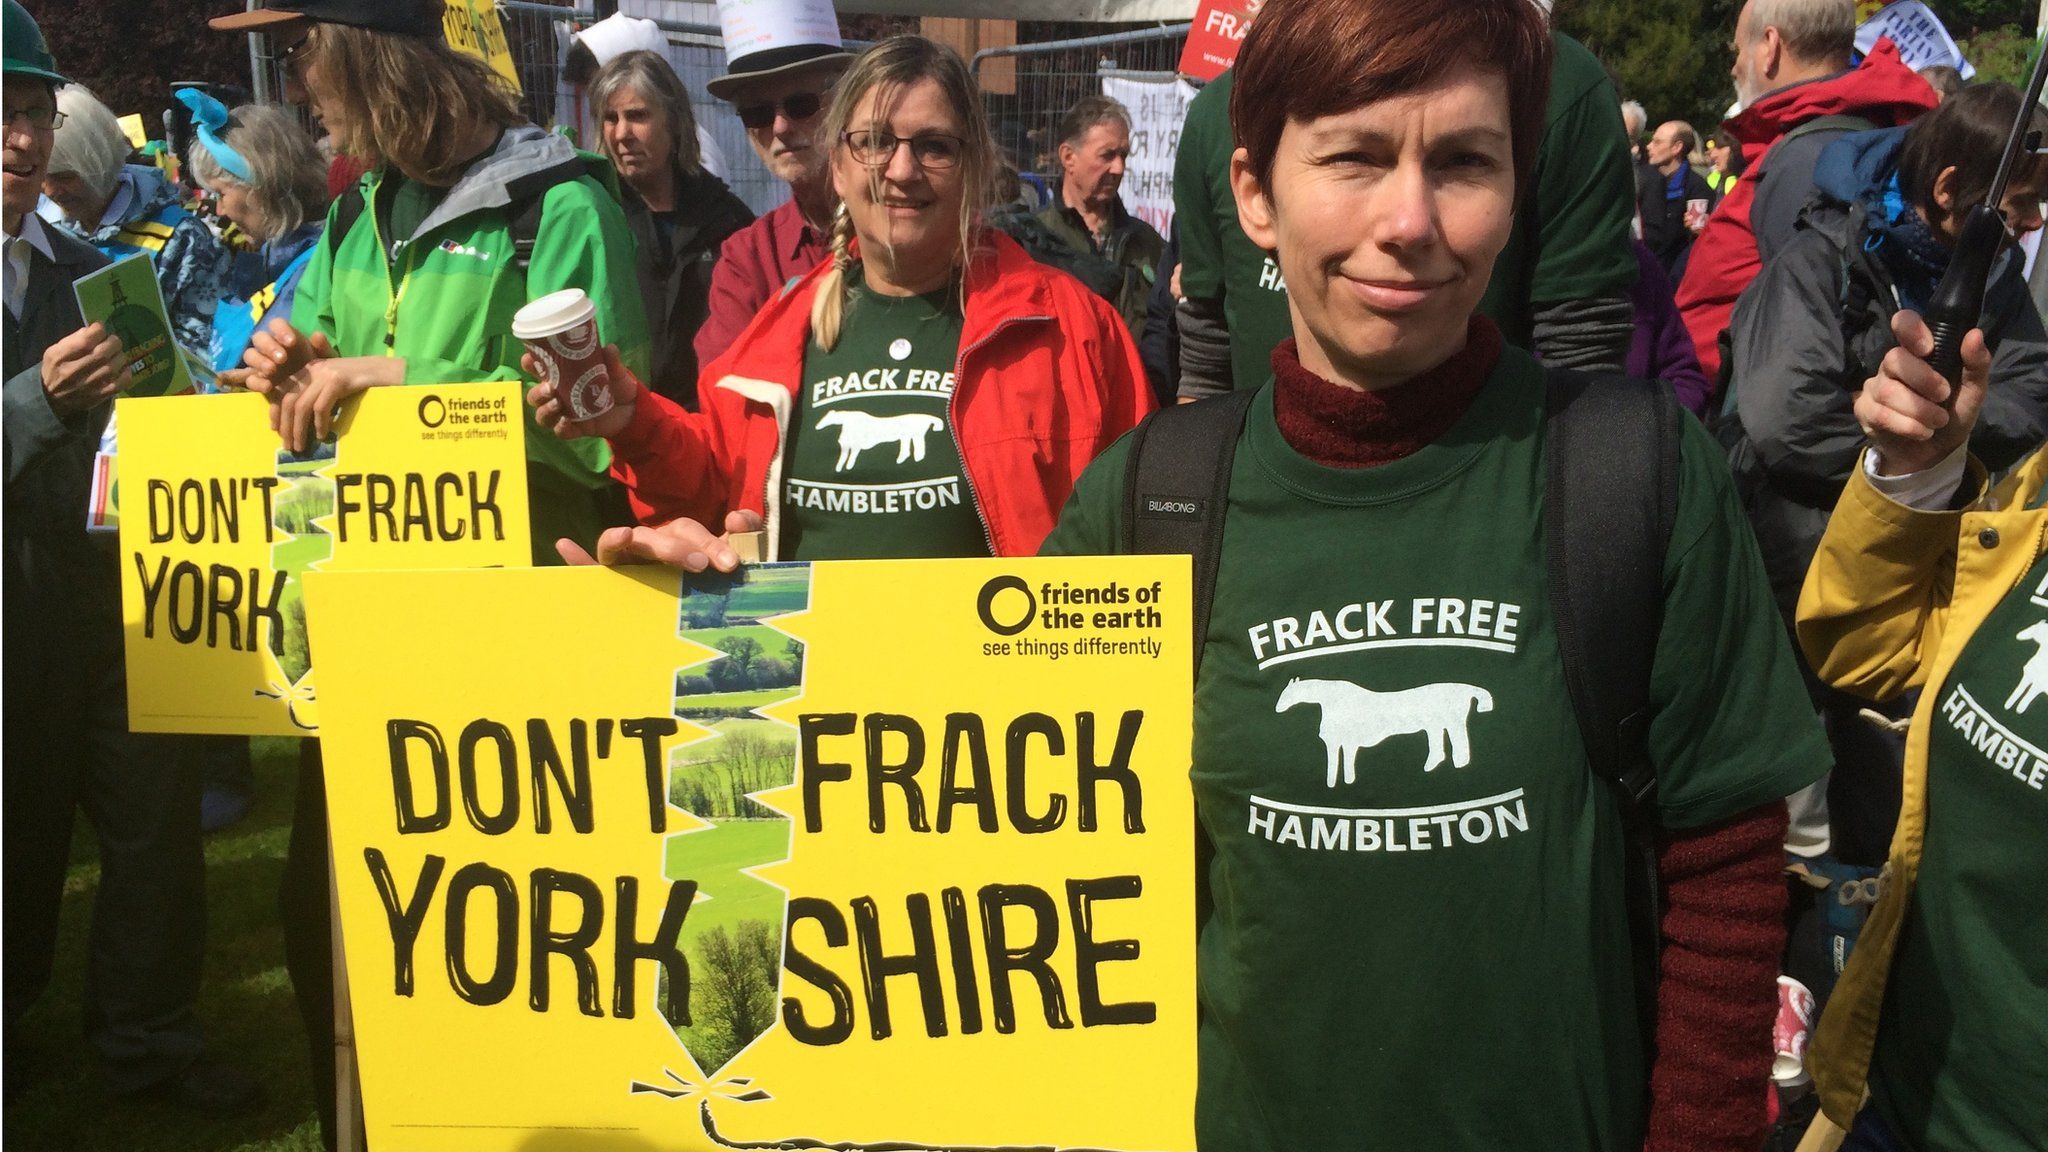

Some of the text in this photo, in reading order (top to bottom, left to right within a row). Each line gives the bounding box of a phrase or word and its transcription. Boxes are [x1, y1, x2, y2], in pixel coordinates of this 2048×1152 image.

[1205, 8, 1253, 41] FRA
[812, 368, 956, 402] FRACK FRE
[448, 396, 506, 411] friends of
[449, 410, 507, 425] the earth
[437, 430, 463, 443] things
[465, 427, 508, 441] differently
[148, 477, 279, 544] DON'T
[335, 470, 505, 543] FRACK
[785, 482, 961, 514] HAMBLETON
[1148, 500, 1196, 514] BILLABONG
[134, 551, 288, 656] YORK
[1041, 581, 1162, 605] friends of
[1041, 606, 1162, 629] the earth
[1248, 598, 1521, 660] FRACK FREE
[983, 636, 1162, 660] see things differently
[1942, 690, 2048, 790] HAMBLE
[387, 709, 1146, 835] DON'T FRACK
[1248, 799, 1529, 851] HAMBLETON
[364, 847, 1157, 1046] YORK SHIRE
